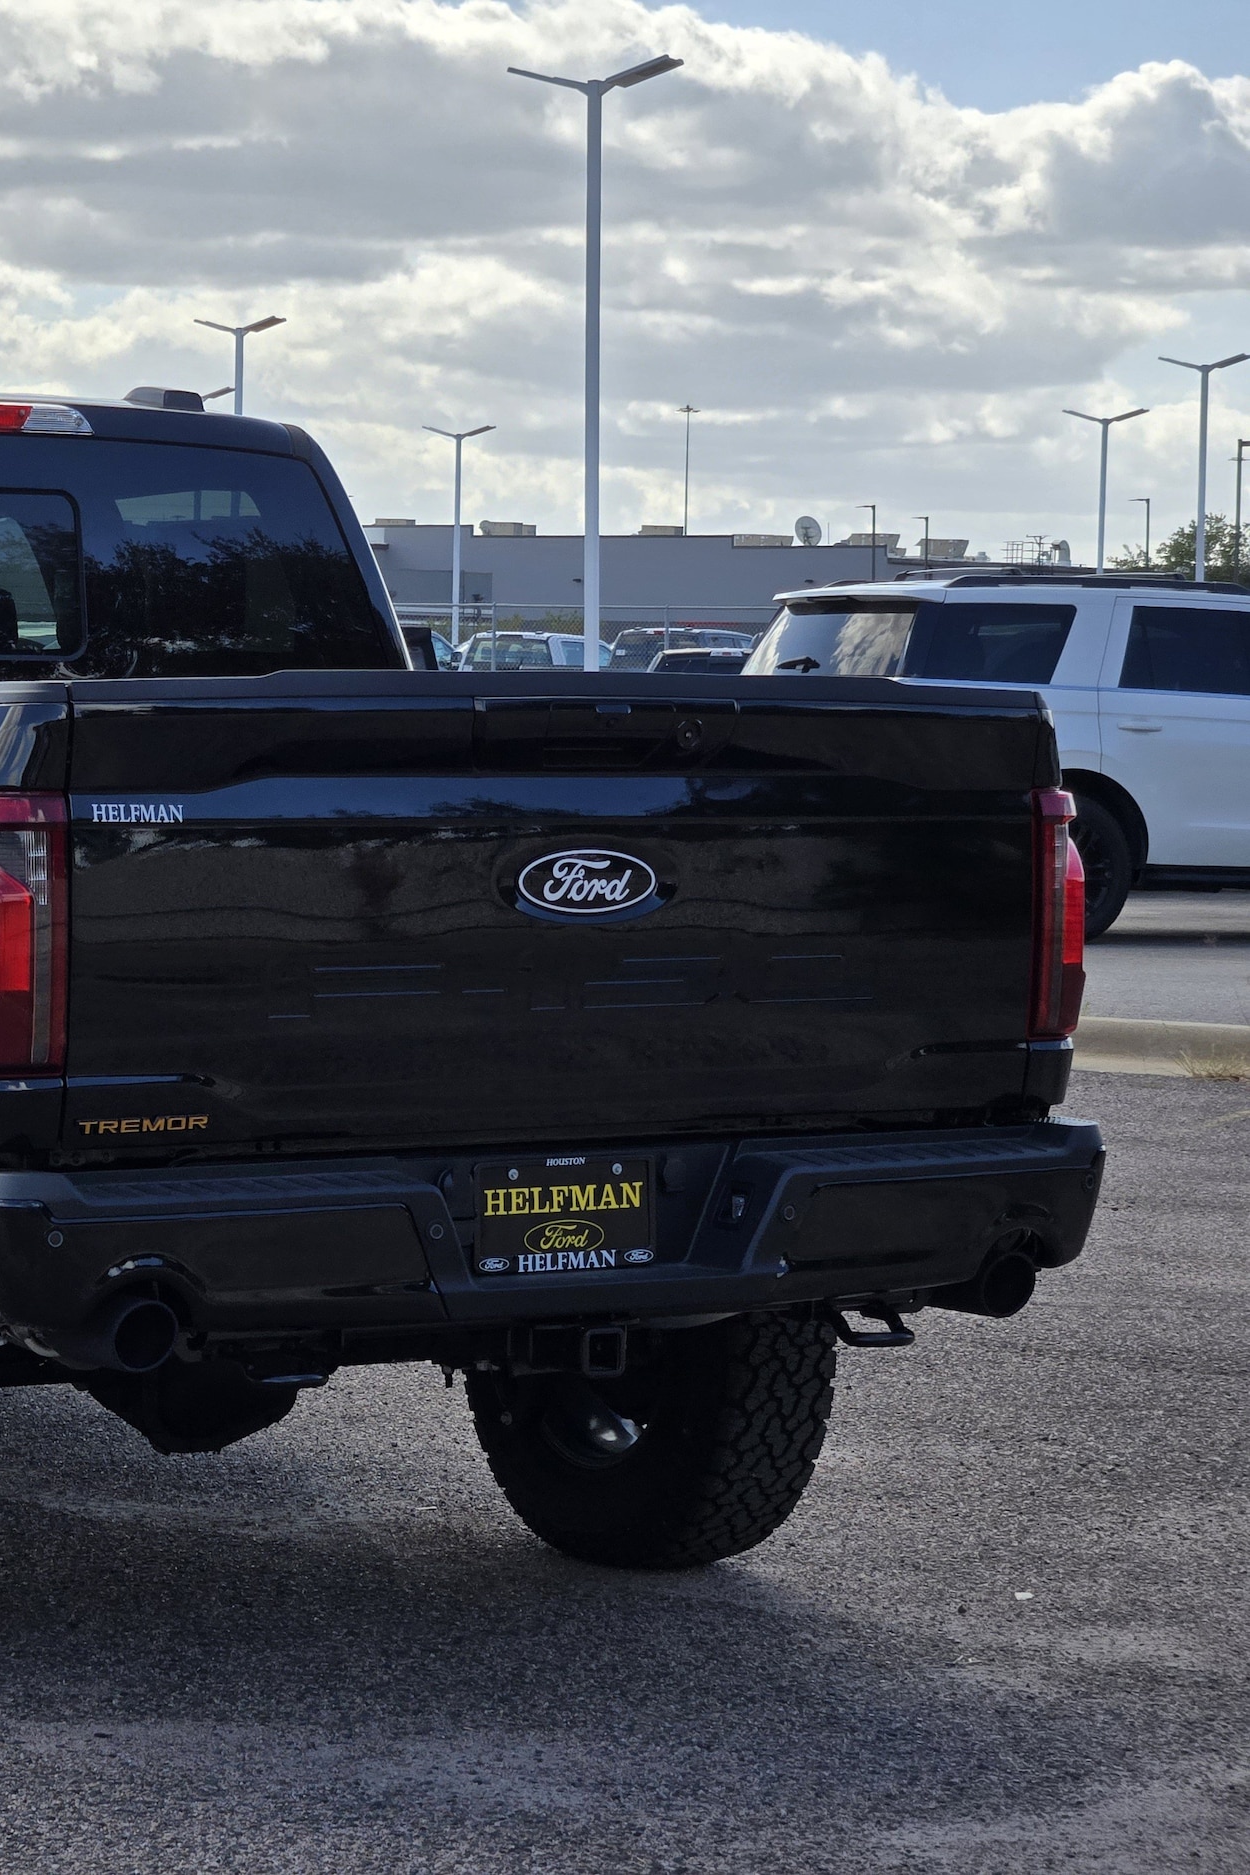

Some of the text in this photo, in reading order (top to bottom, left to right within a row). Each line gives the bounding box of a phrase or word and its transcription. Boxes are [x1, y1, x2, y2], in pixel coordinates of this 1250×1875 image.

[91, 803, 184, 823] HELFMAN
[543, 858, 633, 902] Ford
[78, 1114, 209, 1135] TREMOR
[546, 1156, 586, 1167] HOUSTON
[483, 1181, 644, 1216] HELFMAN
[539, 1224, 590, 1250] Ford
[517, 1249, 616, 1273] HELFMAN
